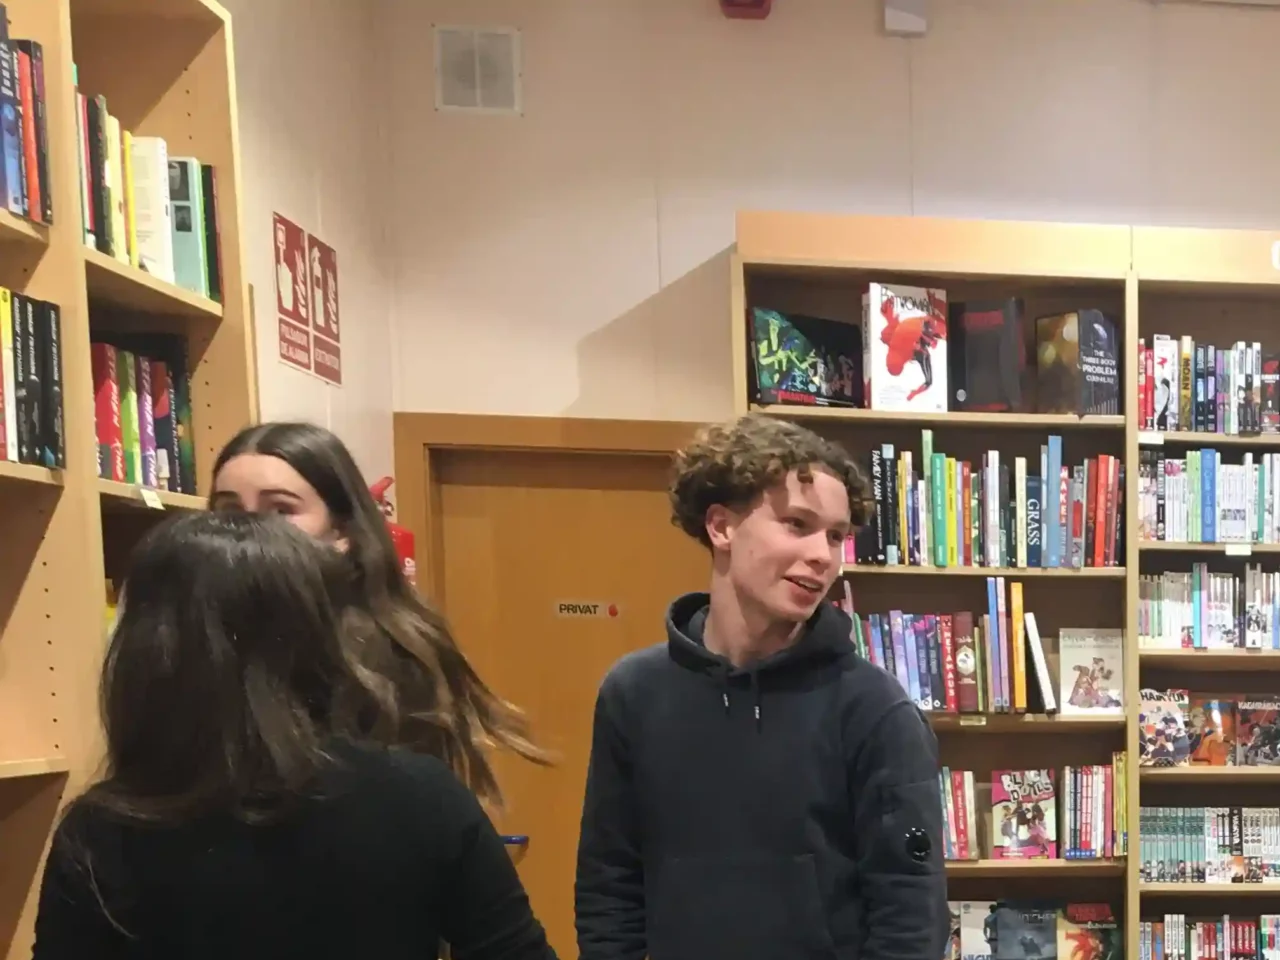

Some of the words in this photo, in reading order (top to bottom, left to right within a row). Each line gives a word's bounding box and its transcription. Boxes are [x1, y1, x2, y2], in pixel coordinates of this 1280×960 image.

[1082, 364, 1117, 376] PROBLEM
[874, 478, 883, 500] MAN
[1027, 498, 1040, 546] GRASS
[558, 603, 599, 616] PRIVAT
[944, 630, 956, 697] METAMAUS
